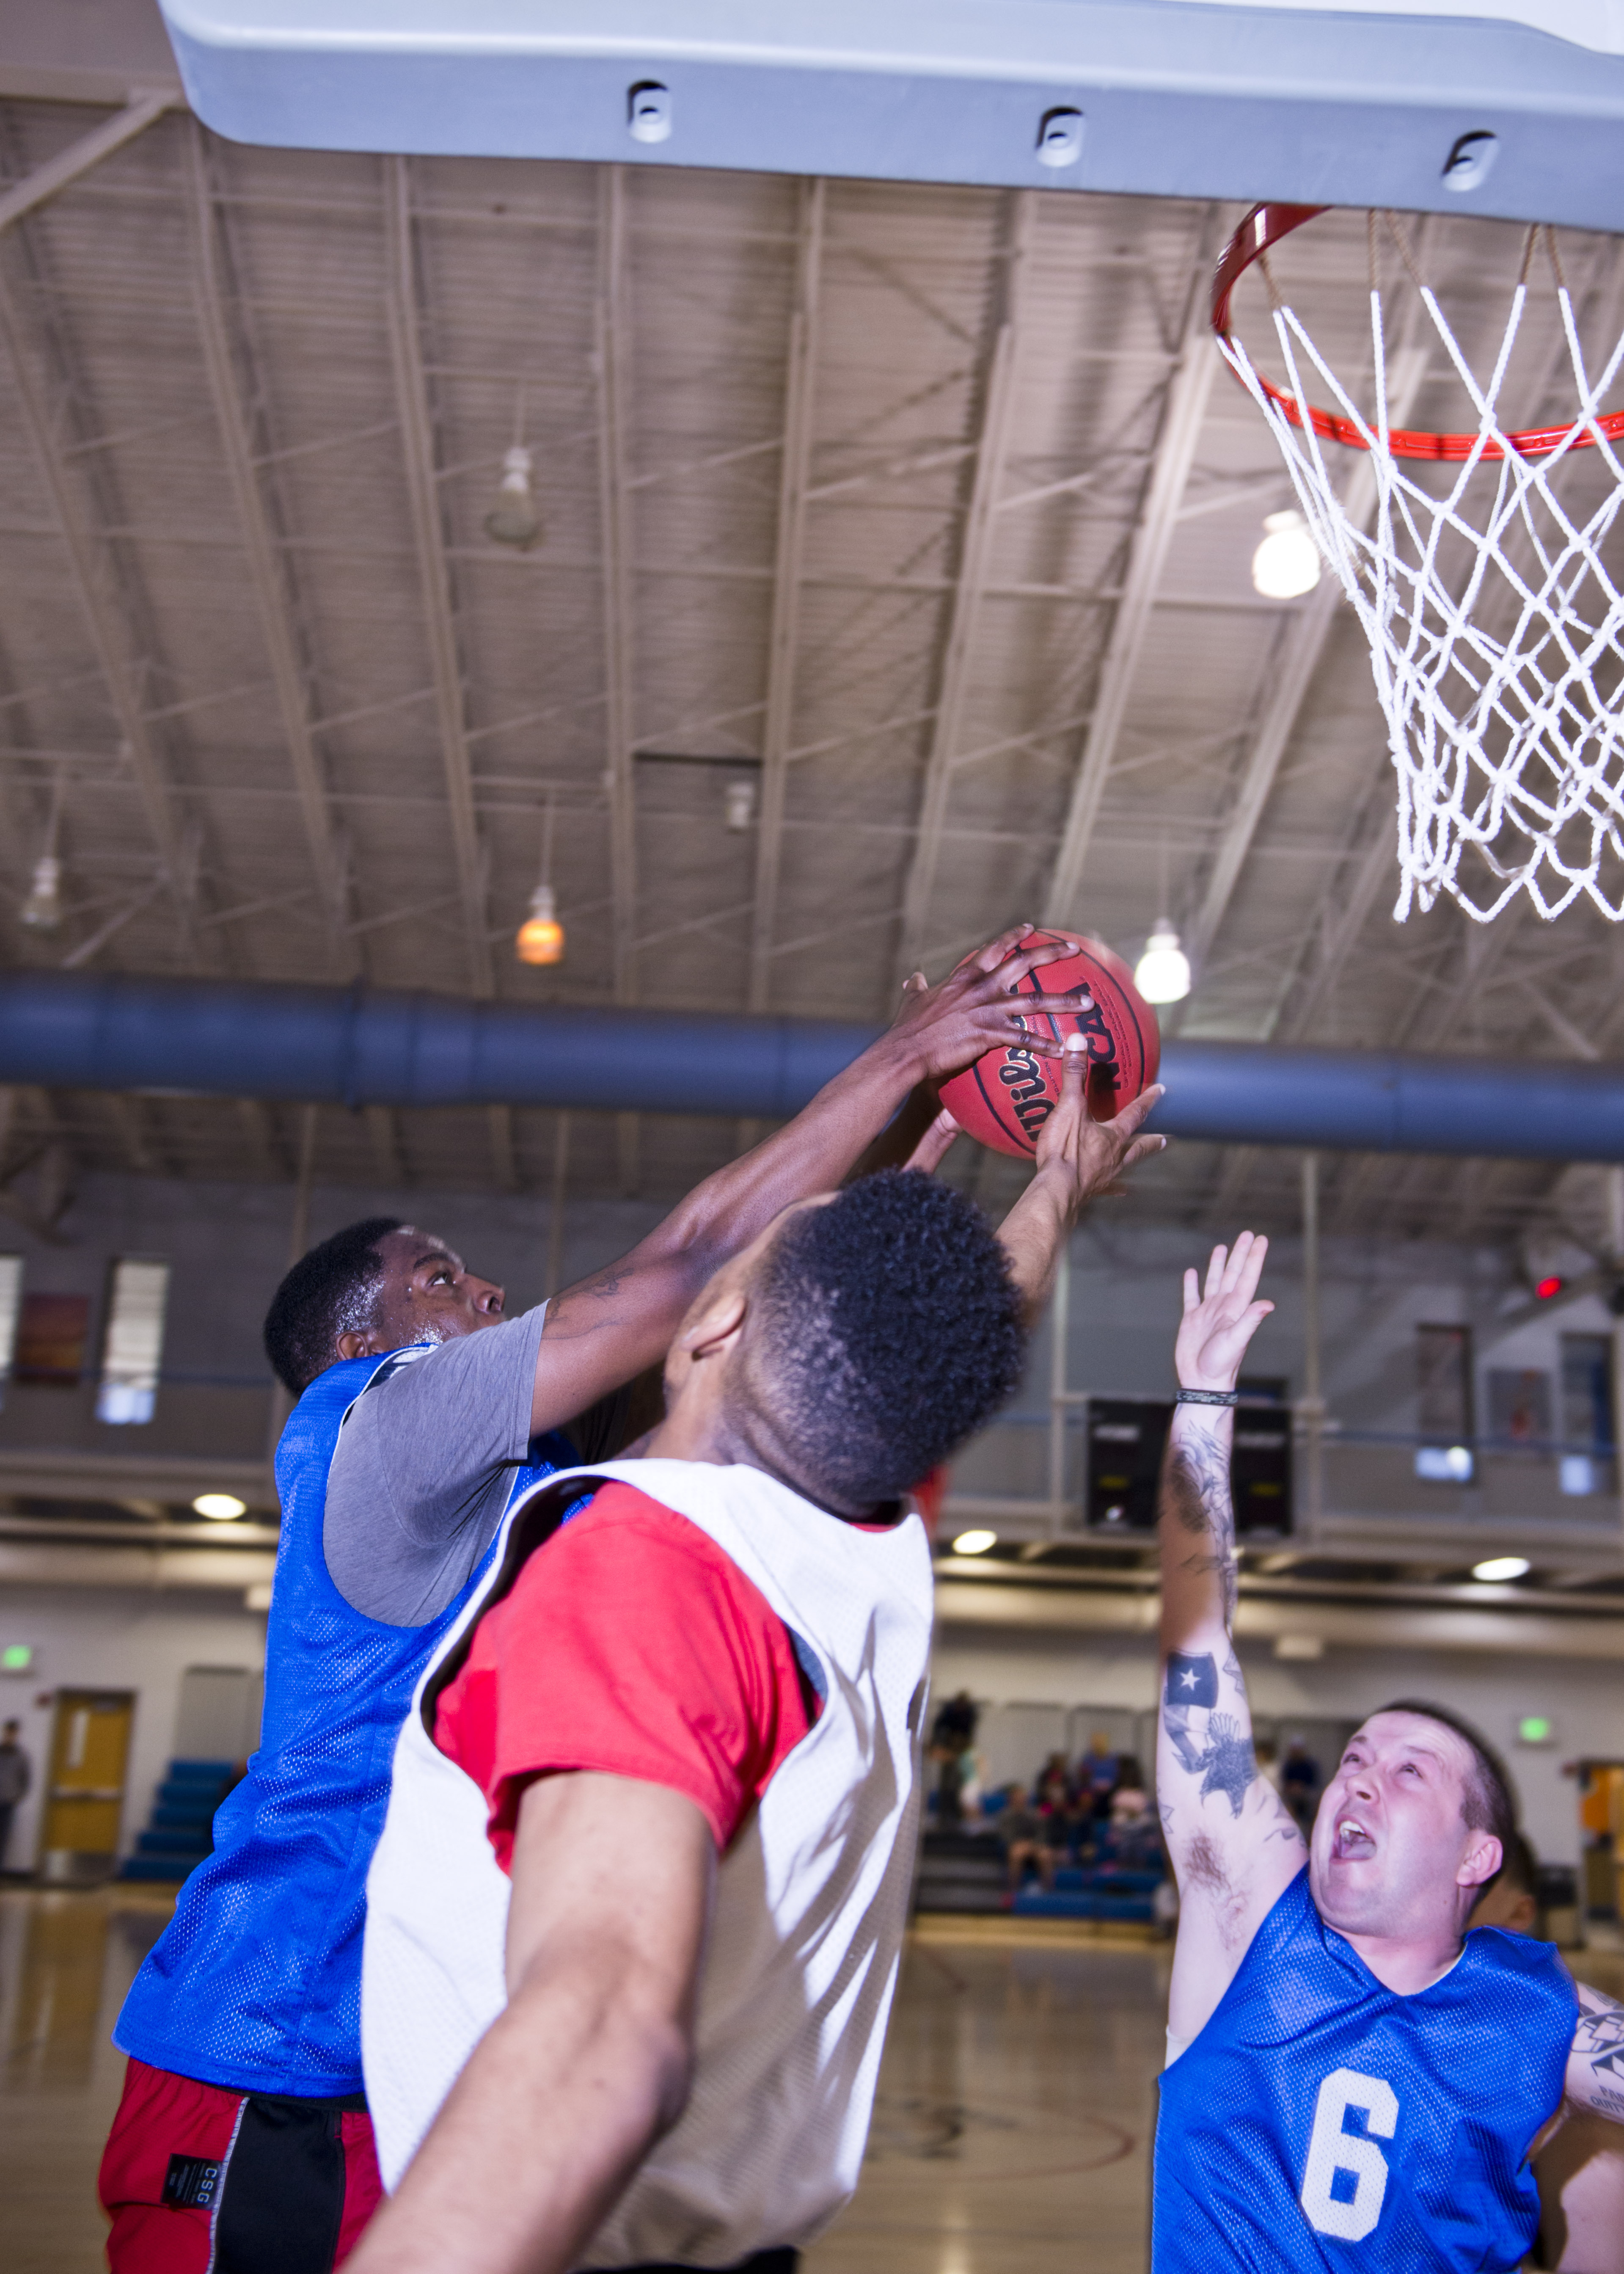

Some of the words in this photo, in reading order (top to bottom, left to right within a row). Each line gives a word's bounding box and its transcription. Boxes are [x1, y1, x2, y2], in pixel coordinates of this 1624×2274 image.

[999, 984, 1057, 1142] Wils
[197, 2167, 217, 2203] CSG
[1301, 2067, 1399, 2242] 6
